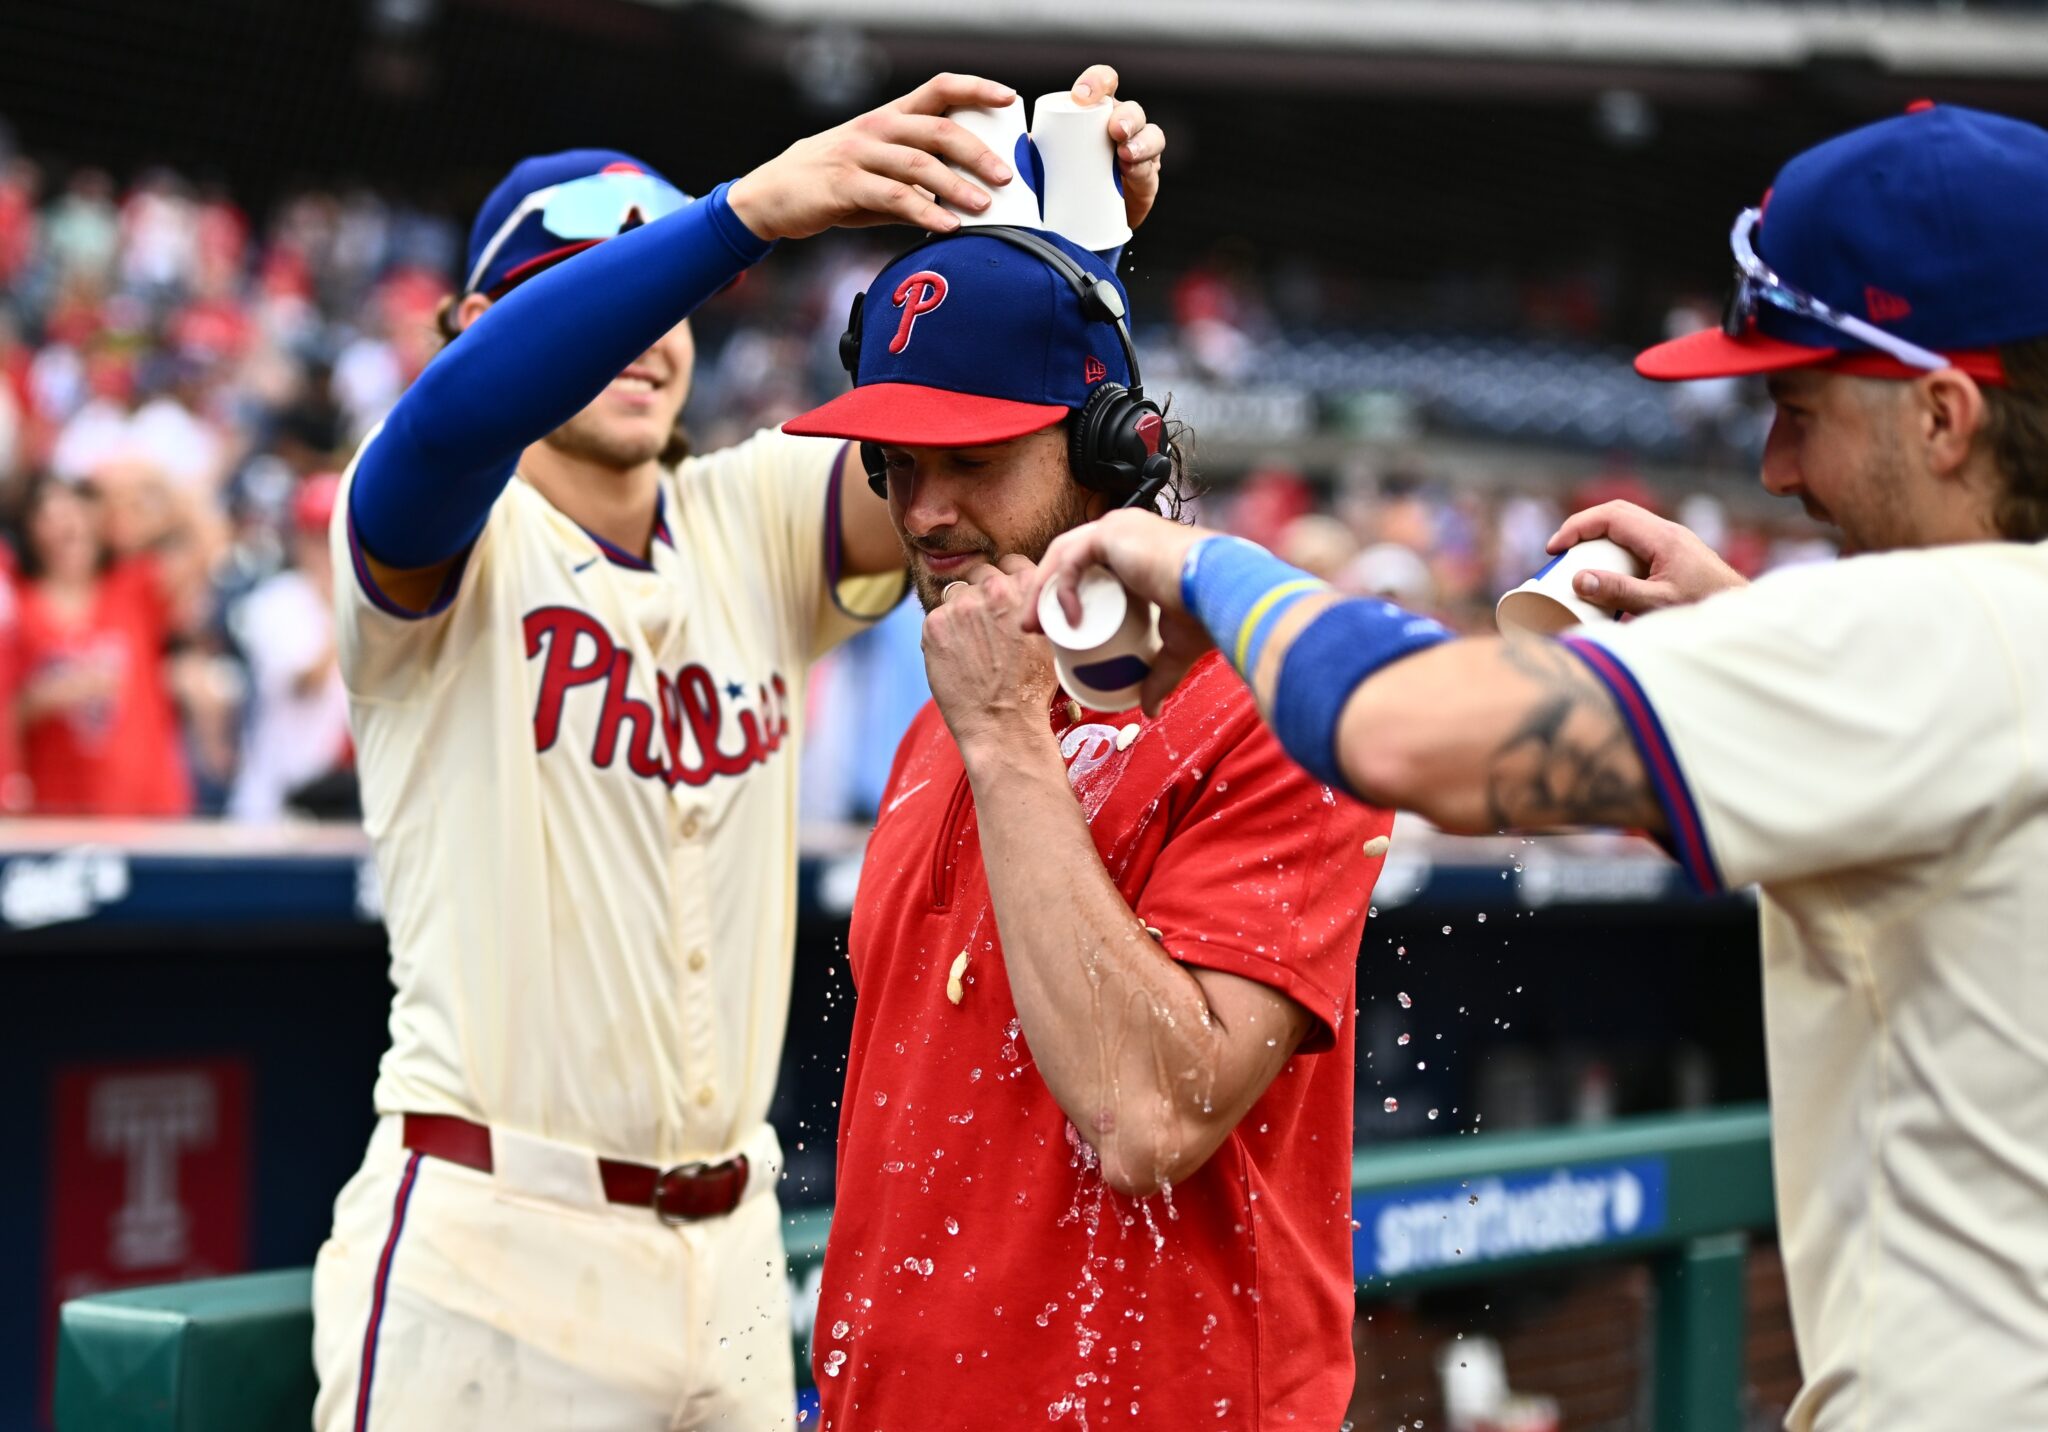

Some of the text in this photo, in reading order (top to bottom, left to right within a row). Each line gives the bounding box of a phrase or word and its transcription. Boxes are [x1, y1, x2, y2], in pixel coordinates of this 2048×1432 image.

[888, 269, 949, 355] P
[522, 605, 789, 788] Phlli
[1060, 723, 1119, 784] P
[87, 1072, 217, 1268] T
